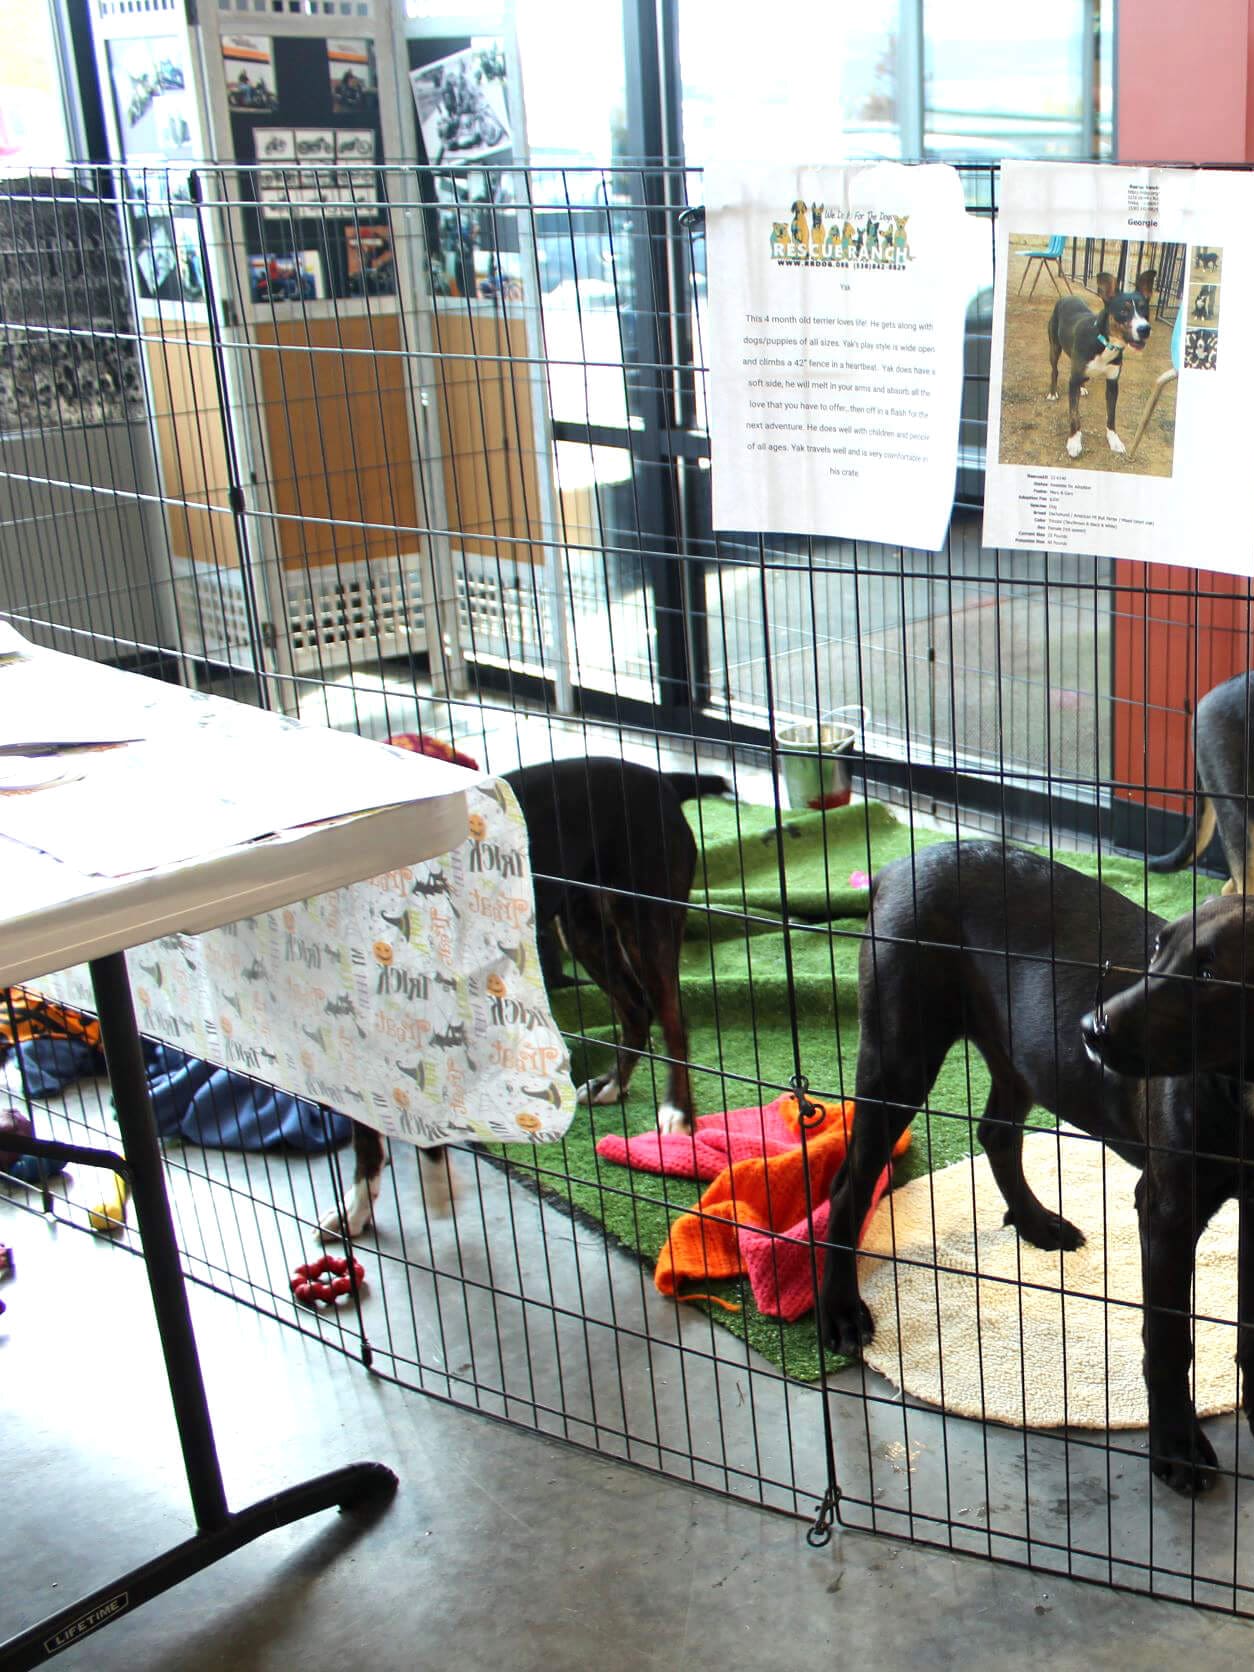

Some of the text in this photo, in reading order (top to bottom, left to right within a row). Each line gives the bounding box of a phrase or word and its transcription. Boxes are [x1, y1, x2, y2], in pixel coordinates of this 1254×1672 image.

[855, 211, 864, 219] For
[868, 210, 877, 219] The
[1128, 218, 1158, 228] Georgie
[774, 243, 907, 263] RESCUE RANCH
[745, 315, 762, 323] This
[772, 316, 797, 324] month
[799, 316, 811, 324] old
[813, 317, 835, 325] terrier
[837, 318, 854, 326] loves
[881, 322, 895, 330] gets
[898, 322, 916, 331] along
[919, 323, 933, 331] with
[743, 336, 797, 346] dogs/puppies
[799, 337, 807, 345] of
[809, 338, 818, 346] all
[860, 341, 873, 351] play
[876, 342, 891, 351] style
[900, 344, 916, 352] wide
[743, 358, 757, 366] and
[759, 358, 785, 366] climbs
[809, 360, 830, 368] fence
[831, 360, 838, 368] in
[896, 366, 912, 374] does
[914, 367, 930, 375] have
[748, 379, 763, 387] soft
[766, 380, 784, 389] side,
[785, 380, 795, 388] he
[797, 381, 810, 389] will
[812, 382, 828, 390] melt
[838, 384, 852, 392] your
[873, 385, 885, 394] and
[911, 388, 919, 396] all
[921, 389, 930, 397] the
[750, 400, 766, 409] love
[767, 400, 782, 409] that
[785, 402, 798, 411] you
[801, 402, 818, 410] have
[820, 403, 827, 411] to
[866, 406, 876, 414] off
[877, 407, 883, 415] in
[890, 407, 906, 416] flash
[746, 422, 763, 430] next
[819, 424, 836, 432] does
[853, 427, 867, 435] with
[869, 428, 894, 436] children
[896, 432, 908, 440] and
[747, 442, 755, 450] of
[791, 444, 805, 452] Yak
[807, 445, 831, 453] travels
[833, 446, 846, 454] well
[848, 448, 860, 456] and
[869, 450, 882, 459] very
[830, 467, 840, 475] his
[55, 1600, 120, 1645] LIFETIME
